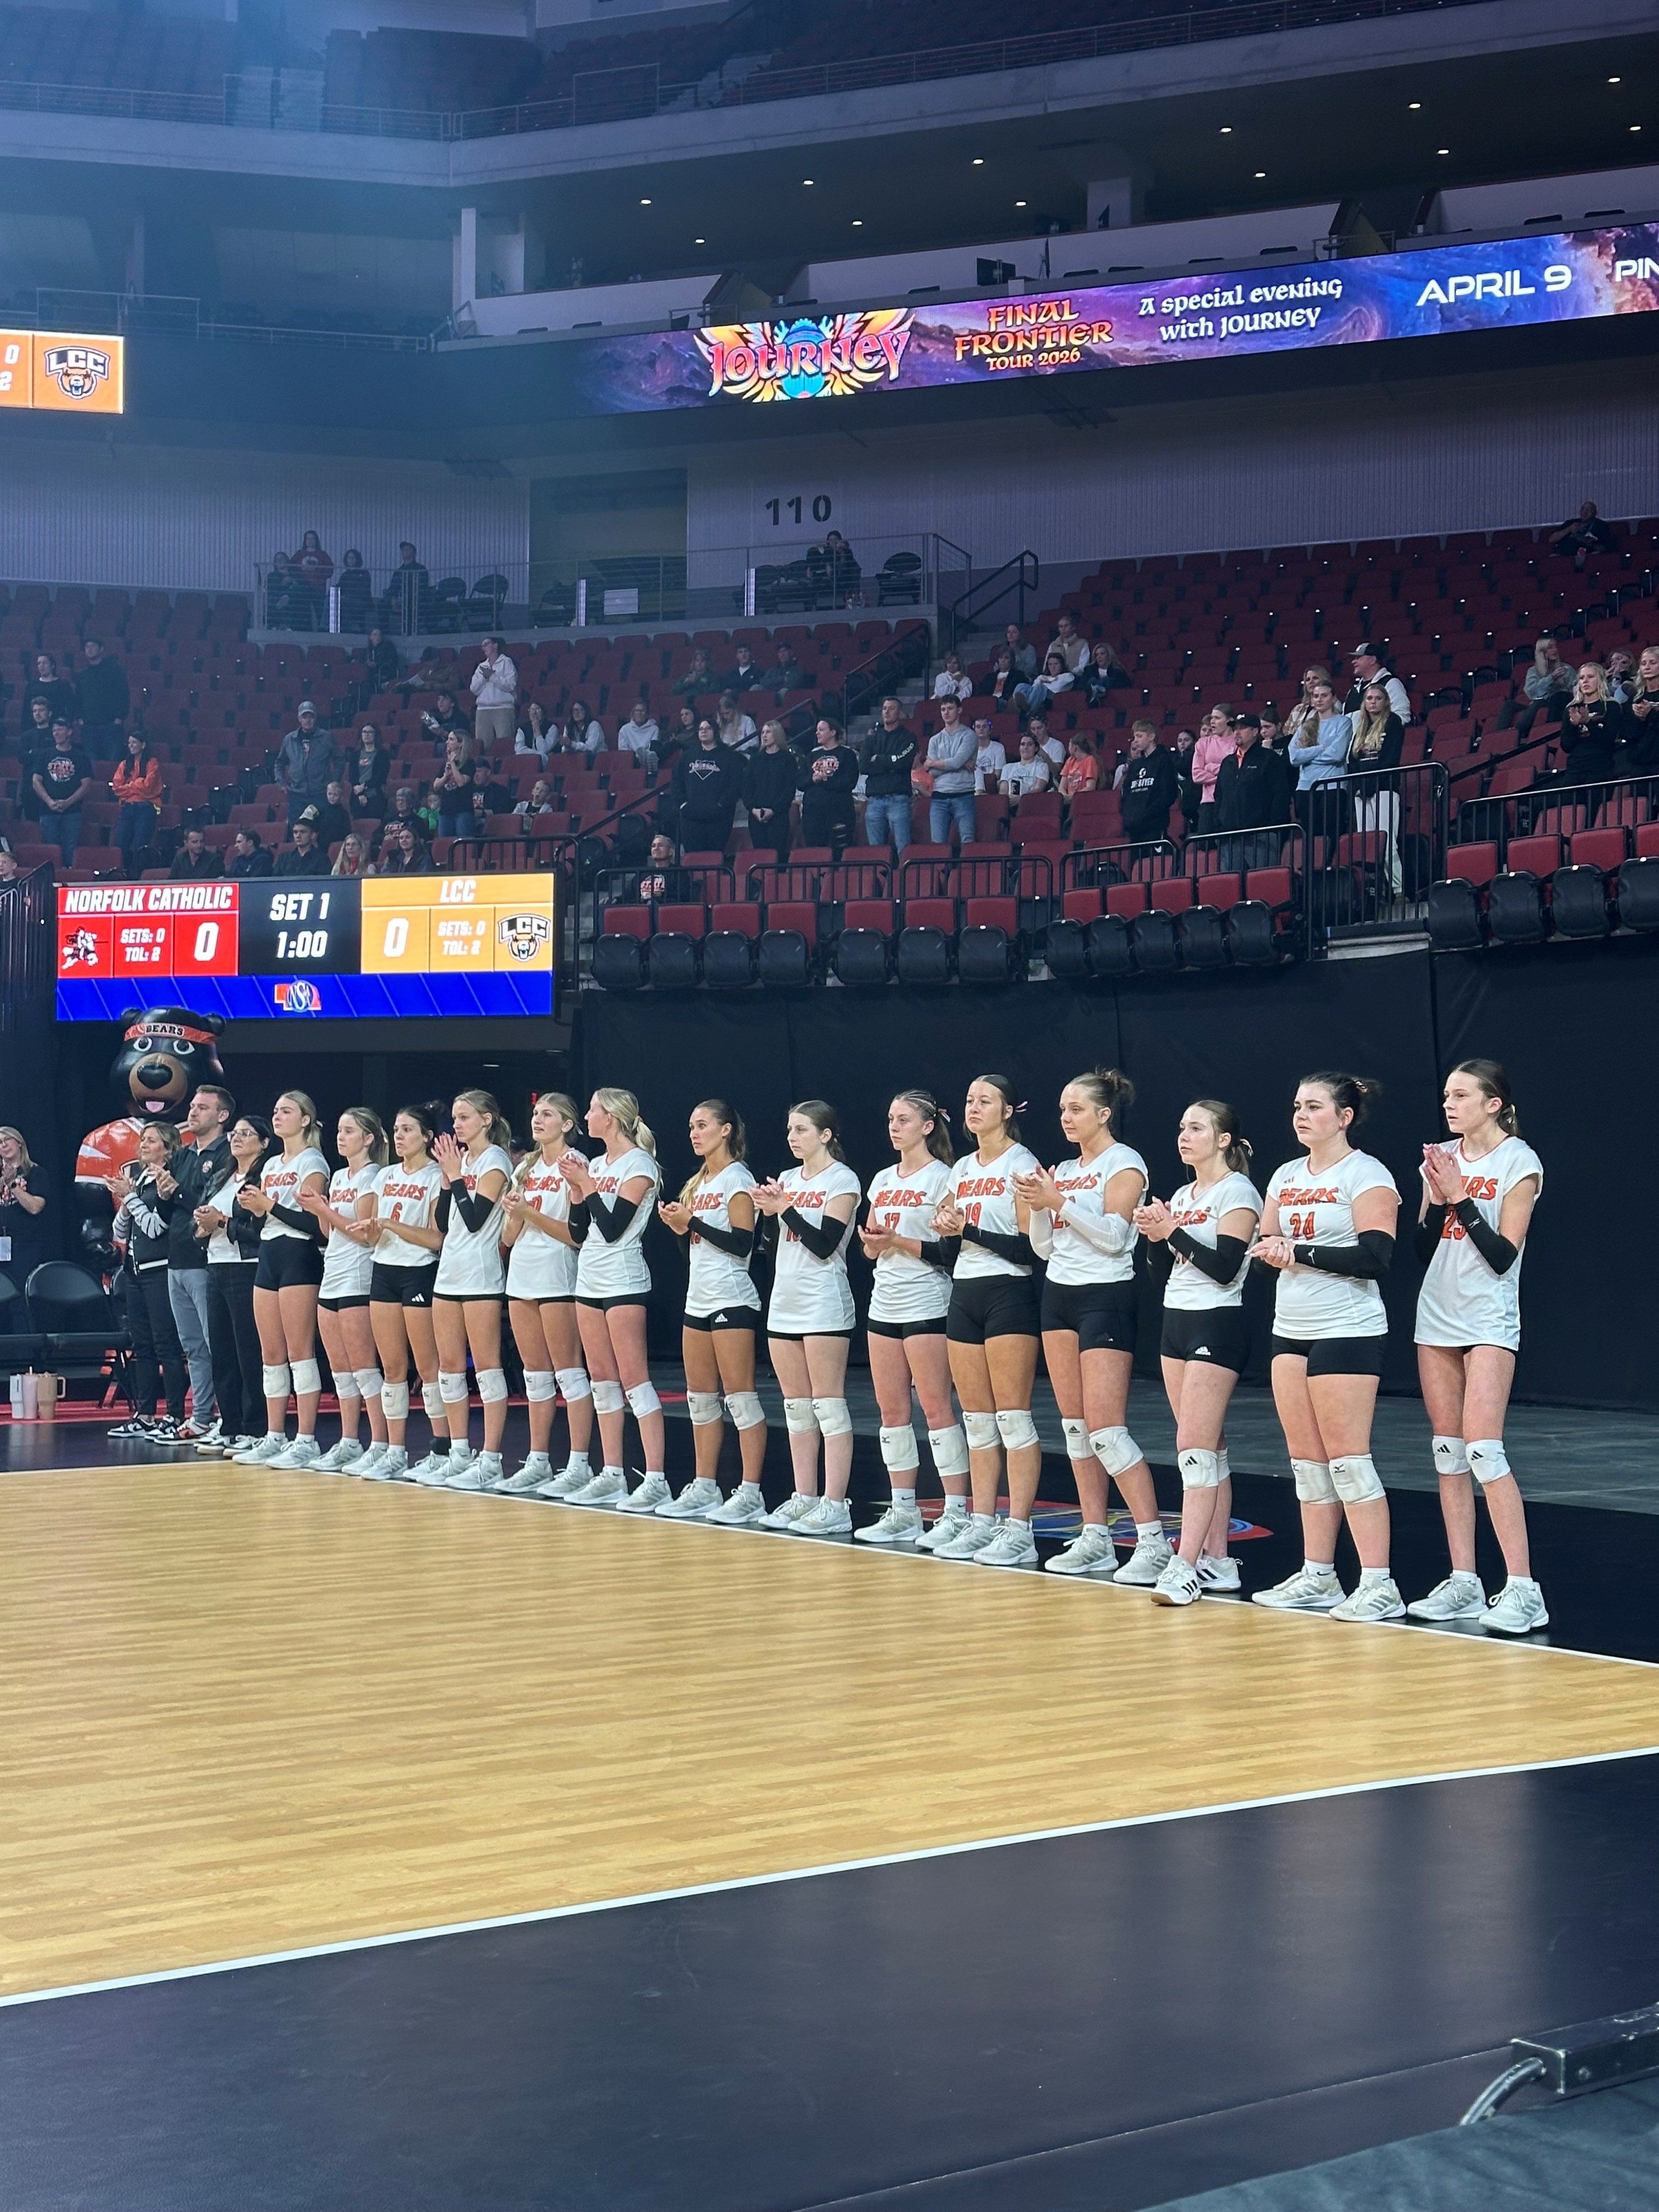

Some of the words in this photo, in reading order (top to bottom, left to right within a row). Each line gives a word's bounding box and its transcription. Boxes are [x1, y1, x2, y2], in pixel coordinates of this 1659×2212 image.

[1139, 297, 1155, 315] A
[1161, 285, 1245, 317] special
[1250, 277, 1342, 298] evening
[1416, 269, 1536, 307] APRIL
[1544, 264, 1572, 292] 9
[988, 299, 1080, 332] FINAL
[1159, 317, 1214, 341] with
[1220, 307, 1321, 338] JOURNEY
[955, 321, 1114, 362] FRONTIER
[48, 349, 105, 374] LCC
[986, 355, 1034, 371] TOUR
[1038, 347, 1081, 365] 2026
[765, 494, 832, 526] 110
[65, 889, 146, 913] NORFOLK
[148, 886, 233, 911] CATHOLIC
[439, 879, 476, 903] LCC
[269, 893, 314, 921] SET
[319, 893, 330, 920] 1
[120, 928, 153, 944] SETS:
[155, 928, 166, 943] 0
[383, 917, 409, 957] 0
[438, 921, 473, 936] SETS:
[476, 920, 486, 936] 0
[501, 917, 548, 939] LCC
[125, 947, 149, 962] TOL:
[151, 946, 161, 962] 2
[194, 922, 219, 961] 0
[276, 930, 328, 958] 1:00
[442, 941, 468, 956] TOL:
[471, 940, 481, 955] 2
[145, 1025, 184, 1036] BEARS
[382, 1183, 428, 1201] BEARS
[874, 1189, 928, 1208] BEARS
[956, 1177, 1006, 1200] BEARS
[1279, 1187, 1339, 1206] BEARS
[884, 1212, 901, 1229] 17
[965, 1202, 982, 1228] 19
[1289, 1211, 1316, 1240] 24
